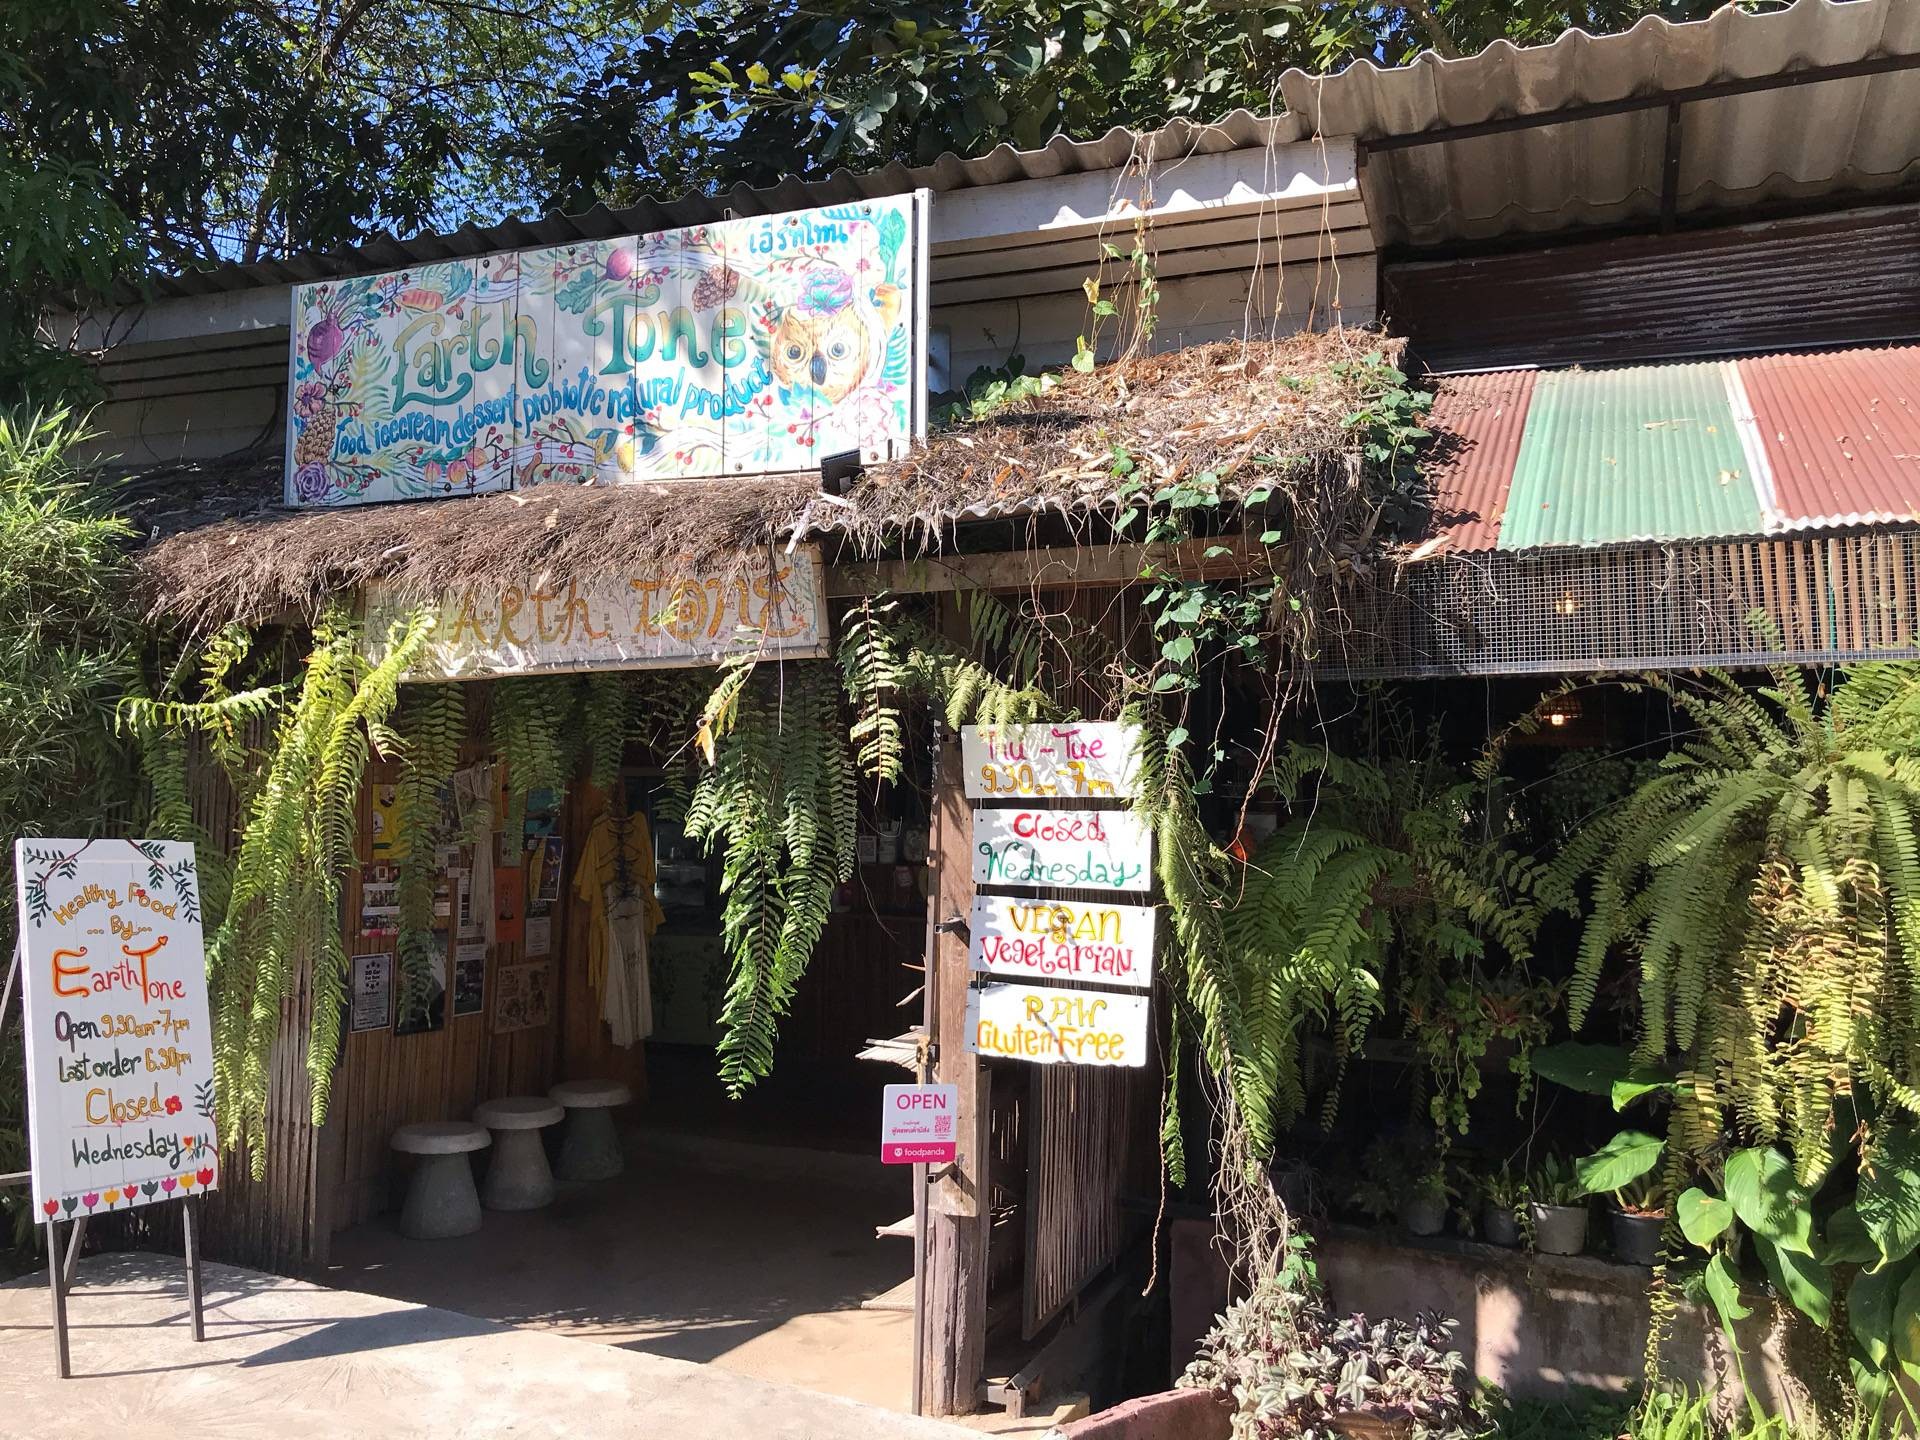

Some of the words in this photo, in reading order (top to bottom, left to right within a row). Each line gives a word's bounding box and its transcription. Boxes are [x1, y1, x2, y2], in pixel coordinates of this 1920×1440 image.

[391, 298, 550, 413] Earth
[583, 284, 747, 376] Tone
[452, 383, 522, 445] dessert
[523, 366, 606, 438] probiotic
[606, 366, 686, 423] natural
[680, 355, 774, 421] product
[1051, 728, 1107, 760] Tue
[1013, 811, 1106, 842] Closed
[978, 841, 1142, 887] Wednesday
[53, 883, 124, 926] Healthy
[128, 882, 178, 921] Food
[52, 945, 142, 998] Earth
[121, 935, 187, 1006] Tone
[55, 1011, 102, 1053] Open
[1023, 995, 1108, 1028] RAW
[1057, 1026, 1125, 1061] Free
[59, 1052, 91, 1083] Last
[92, 1048, 142, 1078] order
[144, 1047, 192, 1076] 6.30pm
[86, 1082, 164, 1125] Closed
[896, 1093, 946, 1110] OPEN
[72, 1128, 188, 1170] Wednesday
[904, 1147, 945, 1157] foodpanda
